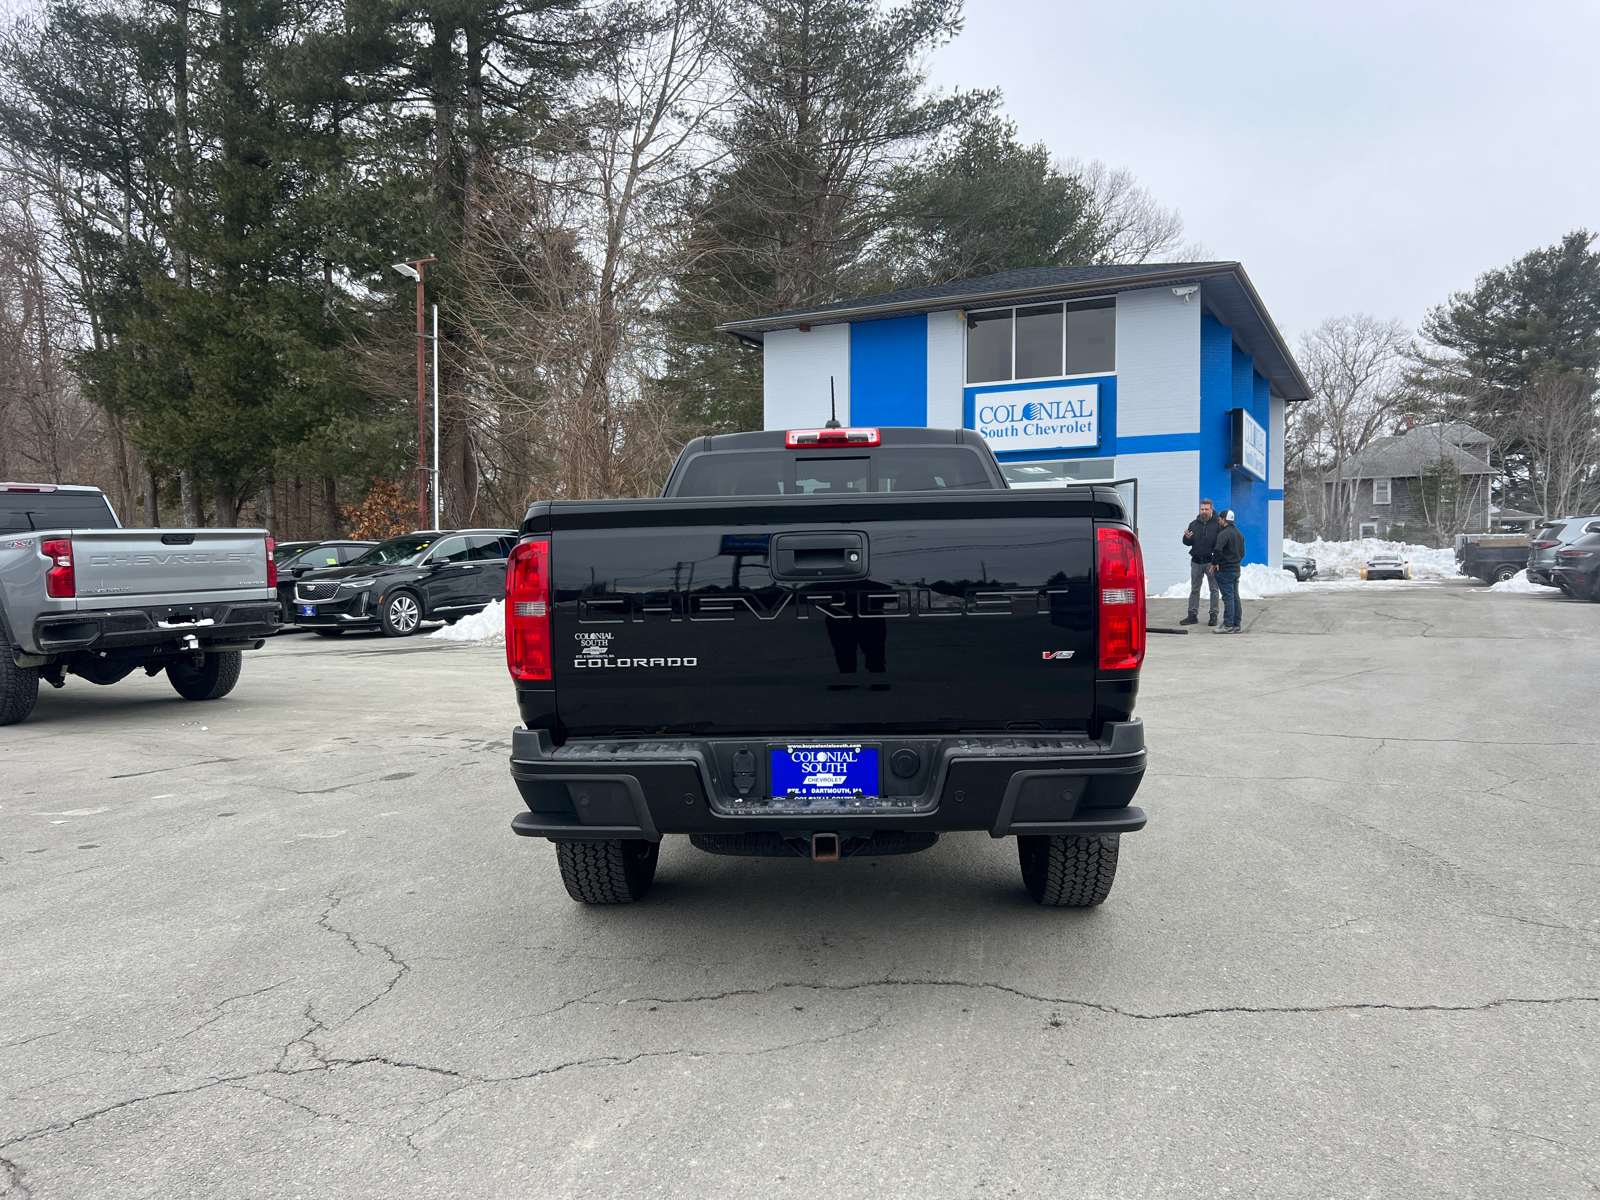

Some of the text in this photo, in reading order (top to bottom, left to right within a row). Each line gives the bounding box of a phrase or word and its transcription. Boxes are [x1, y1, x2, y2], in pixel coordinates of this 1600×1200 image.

[979, 399, 1093, 425] COLONIAL
[979, 420, 1093, 438] South Chevrolet
[89, 552, 256, 568] CHEVROLET
[577, 587, 1069, 623] CHEVROLET
[574, 632, 615, 640] COLONIAL
[580, 639, 609, 647] SOUTH
[1042, 650, 1075, 660] V6
[573, 657, 698, 668] COLORADO
[791, 751, 858, 763] COLONIAL
[801, 762, 848, 773] SOUTH
